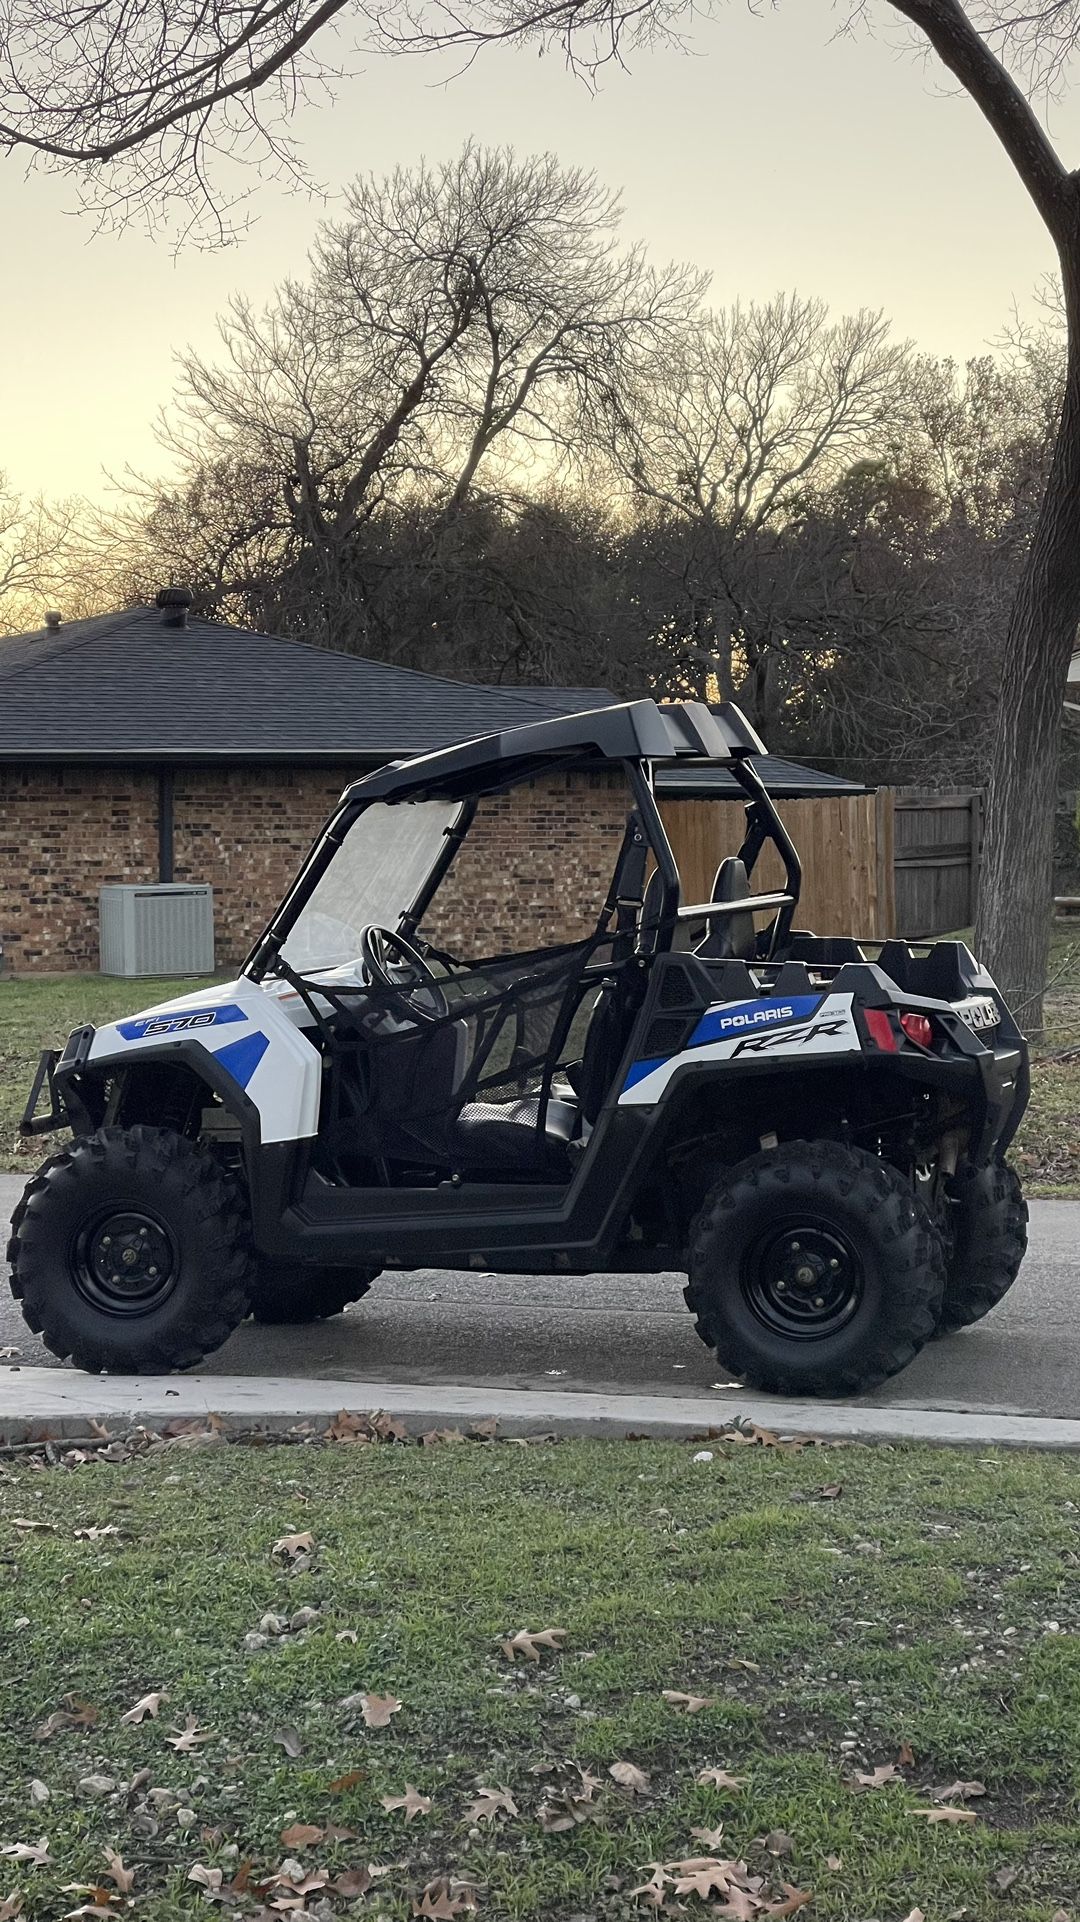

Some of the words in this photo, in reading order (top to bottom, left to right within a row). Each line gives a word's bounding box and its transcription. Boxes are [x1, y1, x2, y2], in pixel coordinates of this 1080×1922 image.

[143, 1012, 216, 1036] 570
[720, 1006, 793, 1029] POLARIS
[730, 1020, 848, 1059] RZR
